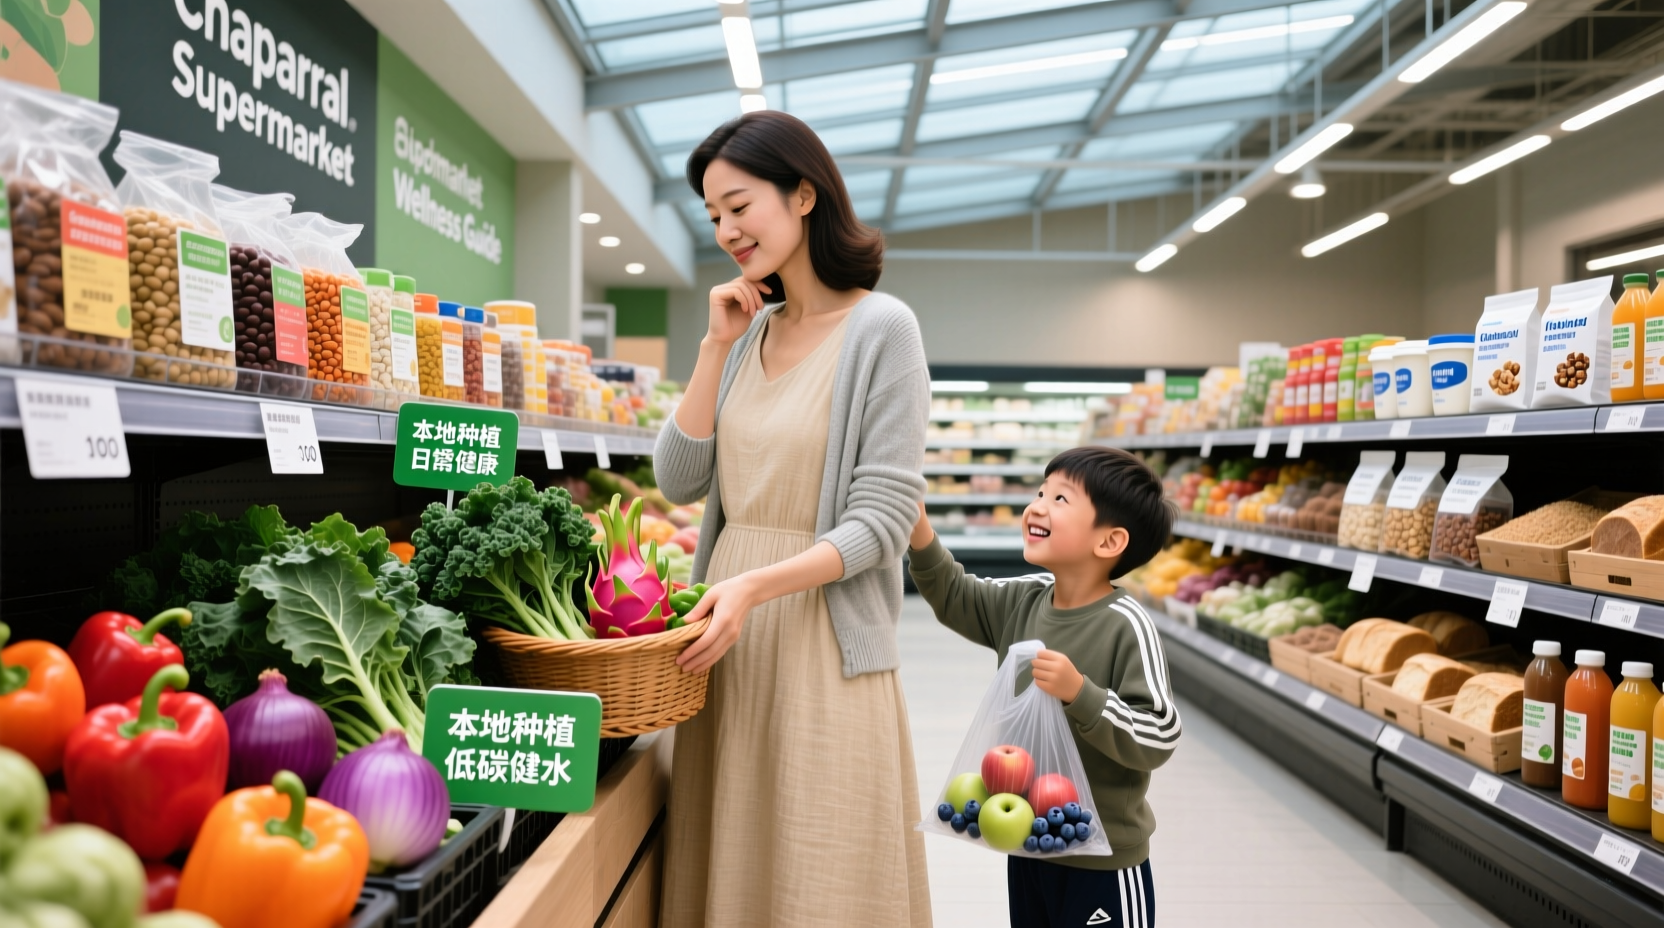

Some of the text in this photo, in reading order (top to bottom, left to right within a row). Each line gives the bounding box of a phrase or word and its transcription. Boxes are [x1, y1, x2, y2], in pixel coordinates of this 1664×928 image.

[172, 40, 354, 187] Supermarket
[393, 167, 502, 265] Wellness Guide
[412, 419, 502, 449] 本地种植
[447, 707, 576, 748] 本地种植
